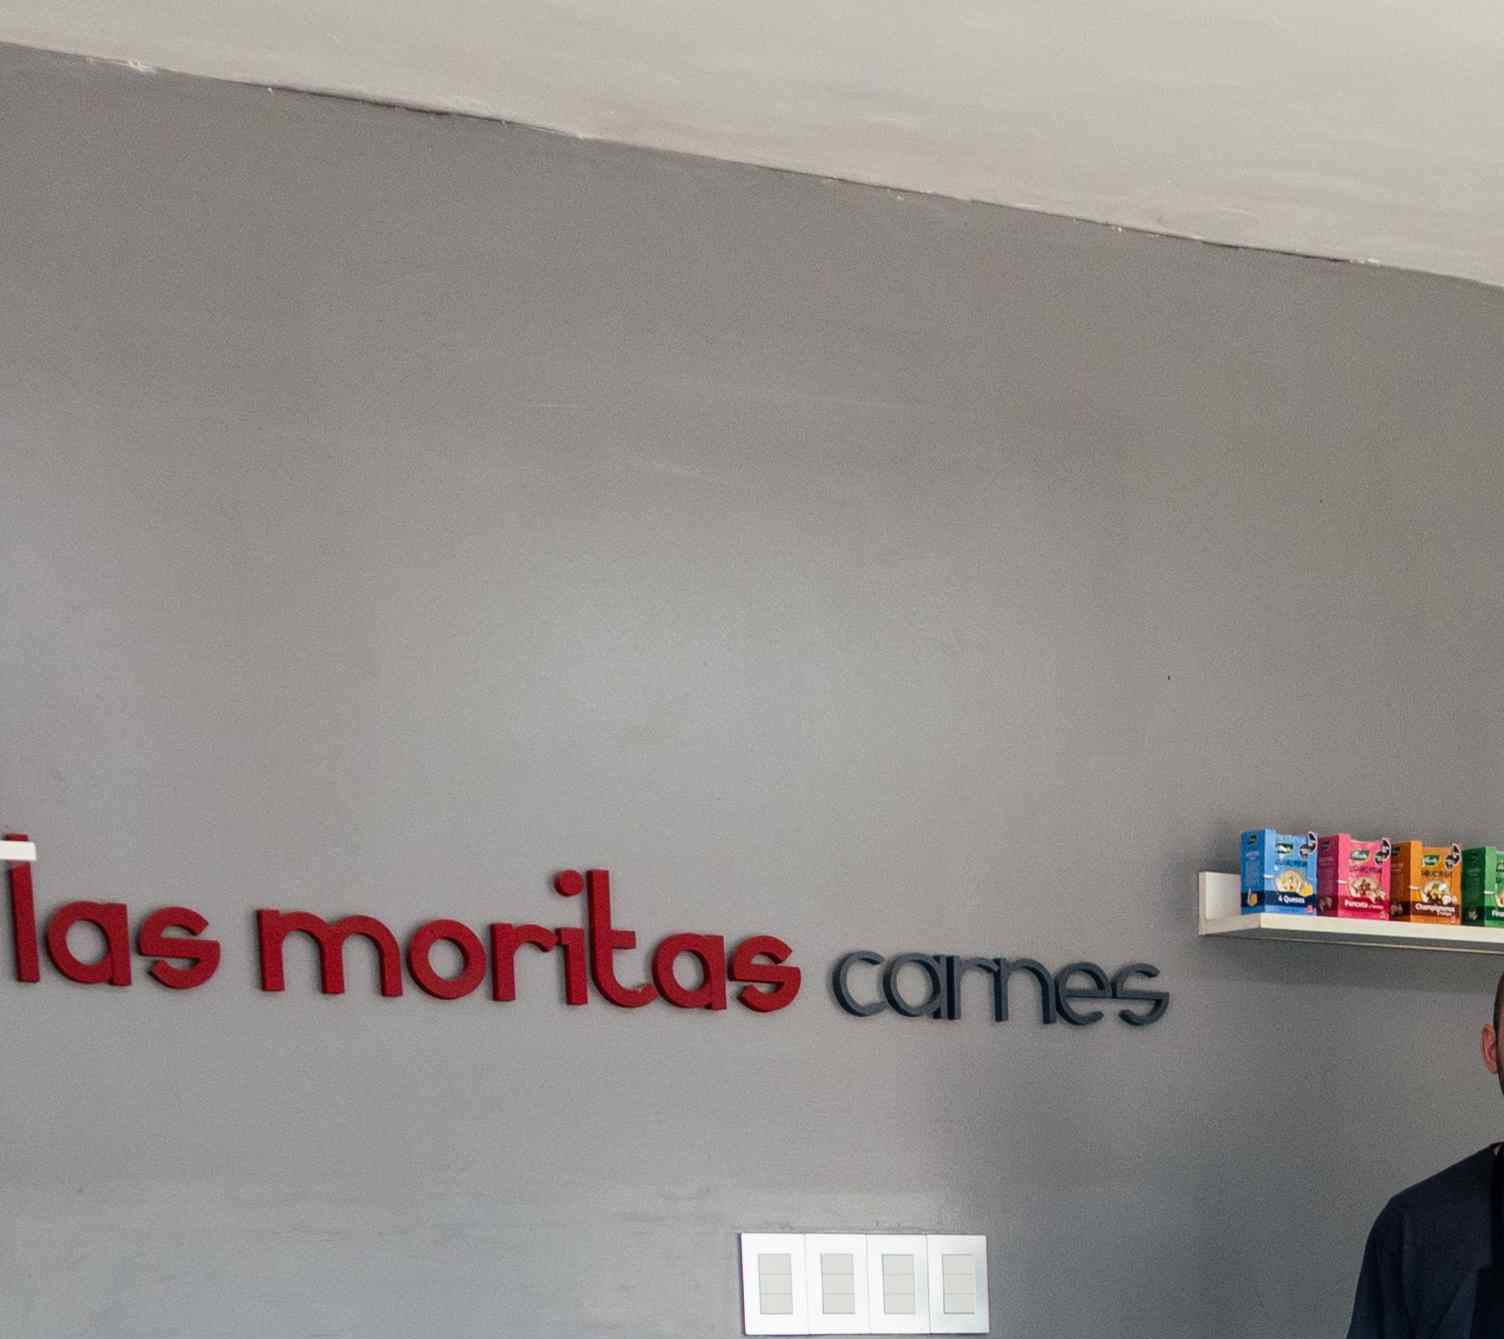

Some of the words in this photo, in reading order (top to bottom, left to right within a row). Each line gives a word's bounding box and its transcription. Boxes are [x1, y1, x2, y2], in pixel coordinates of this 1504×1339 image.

[9, 833, 221, 990] las
[256, 868, 803, 1014] moritas
[831, 948, 1171, 1027] carnes
